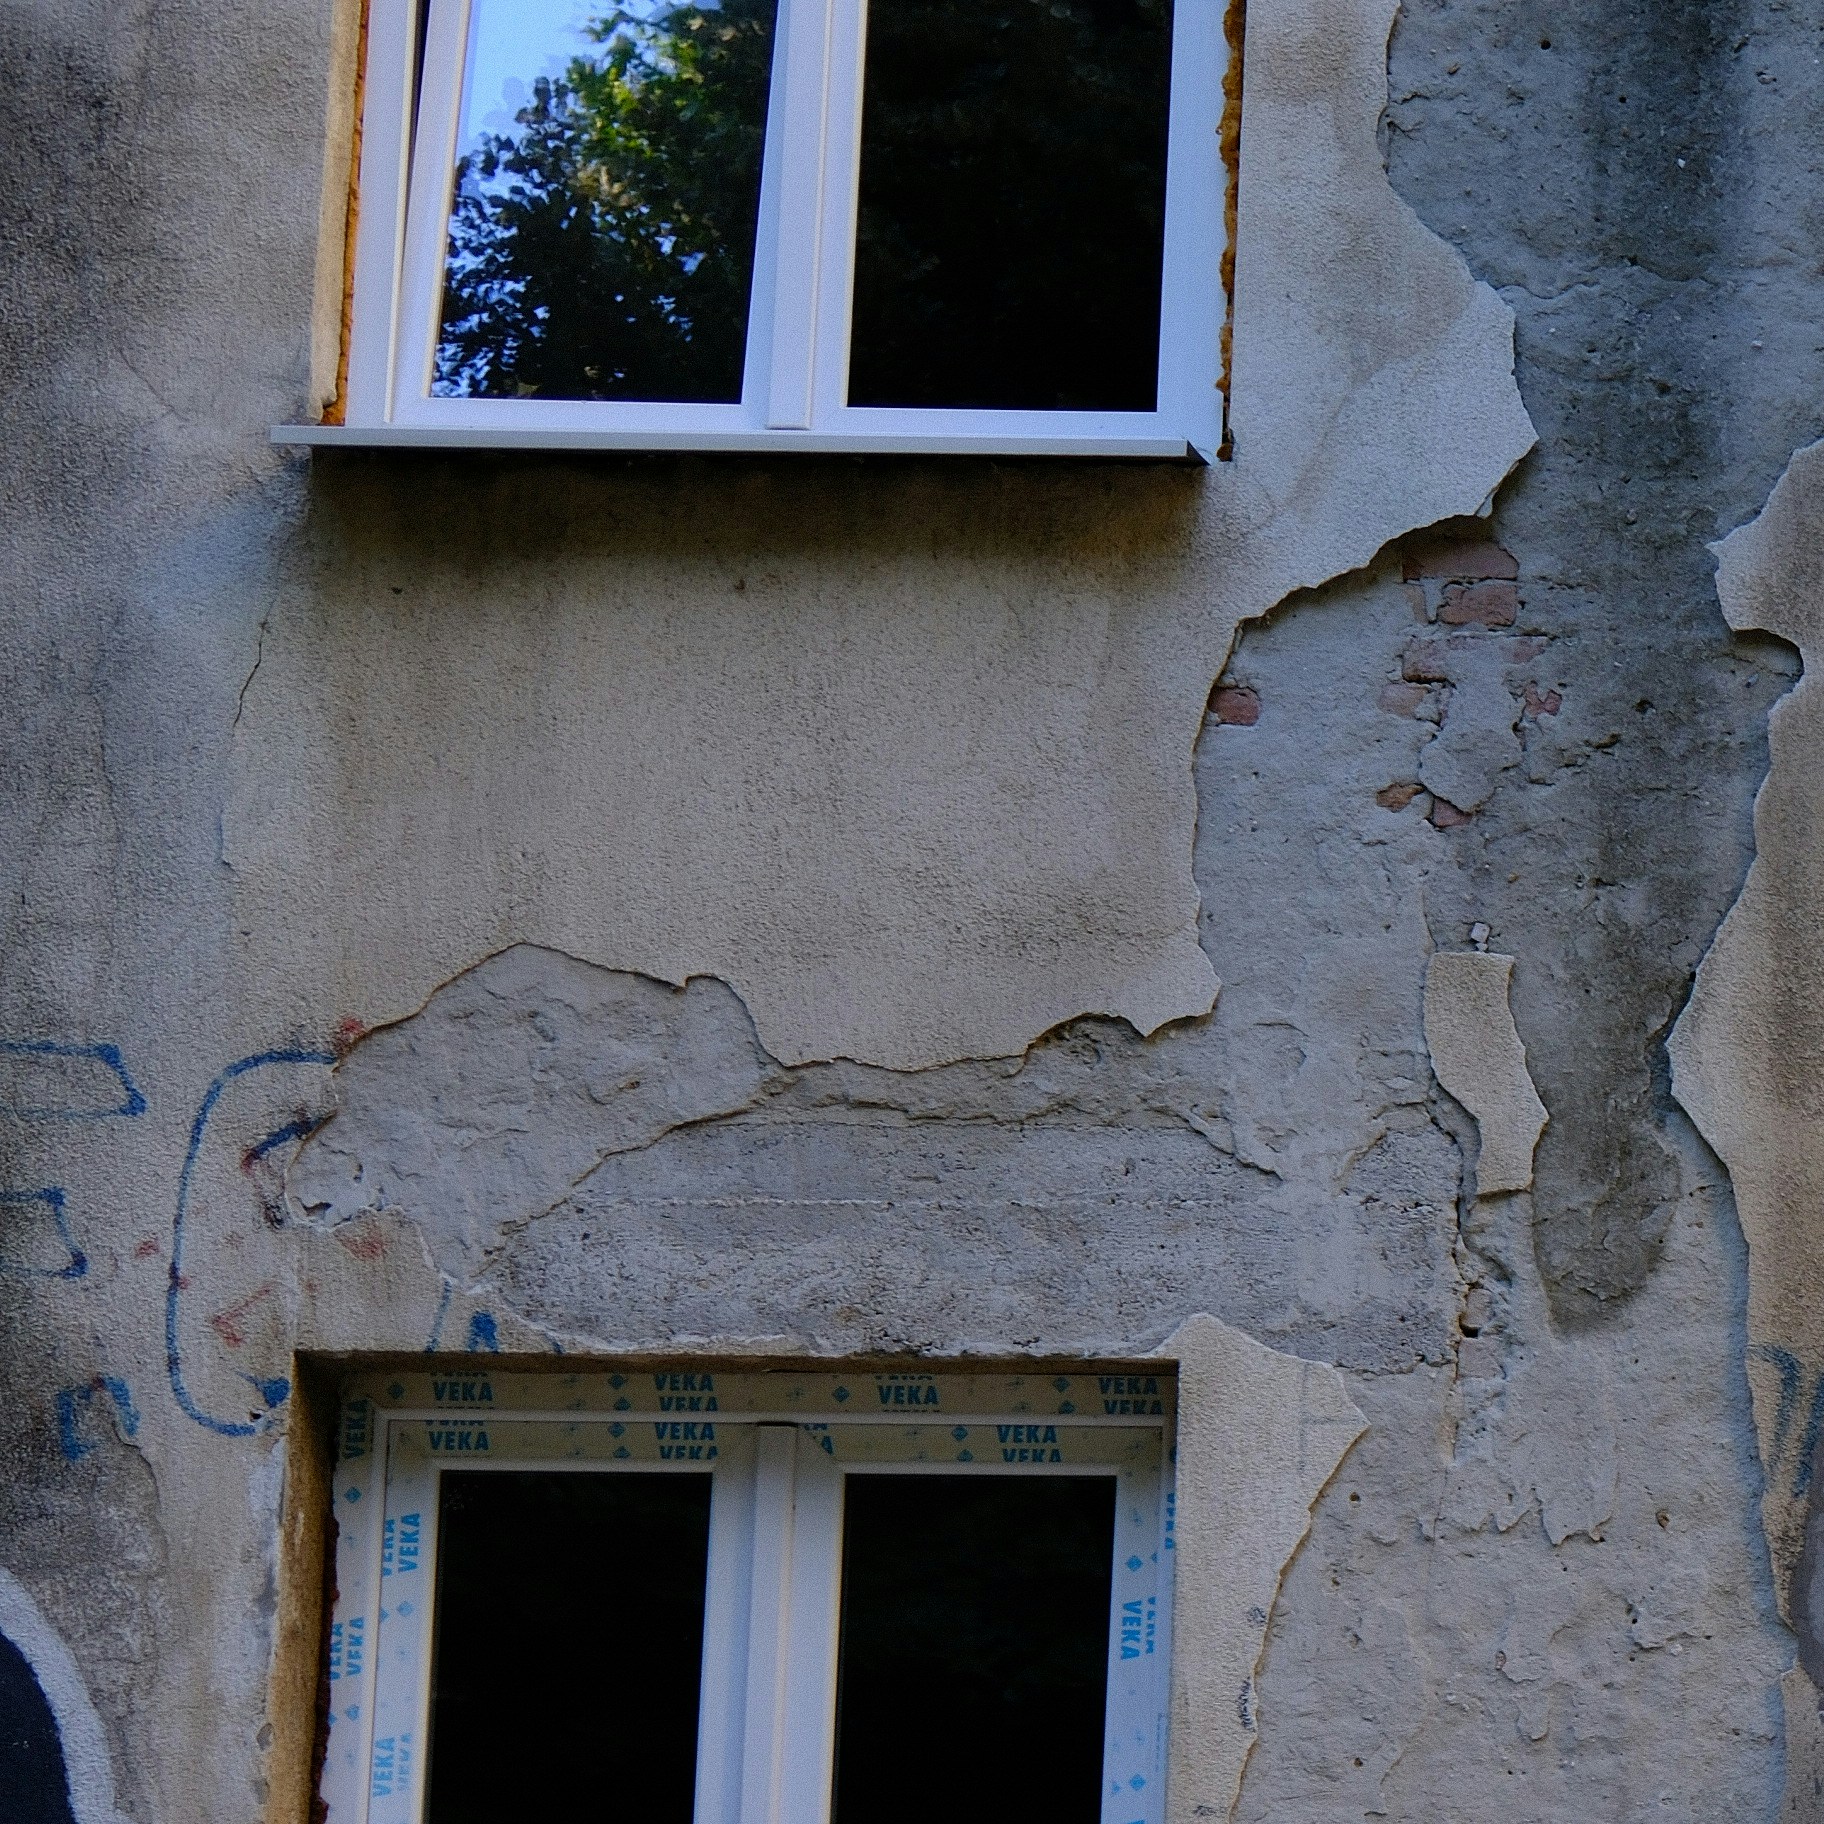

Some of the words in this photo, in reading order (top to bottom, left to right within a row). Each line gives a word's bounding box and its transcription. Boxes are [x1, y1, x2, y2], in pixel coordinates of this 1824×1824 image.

[432, 1381, 494, 1402] VEKA
[653, 1373, 714, 1392] VEKA
[1099, 1377, 1159, 1396] VEKA
[877, 1385, 939, 1406] VEKA
[342, 1397, 369, 1459] VEKA
[654, 1422, 714, 1441] VEKA
[997, 1425, 1058, 1444] VEKA
[429, 1431, 489, 1451] VEKA
[398, 1512, 420, 1572] VEKA
[1121, 1600, 1143, 1660] VEKA
[373, 1736, 395, 1798] VEKA
